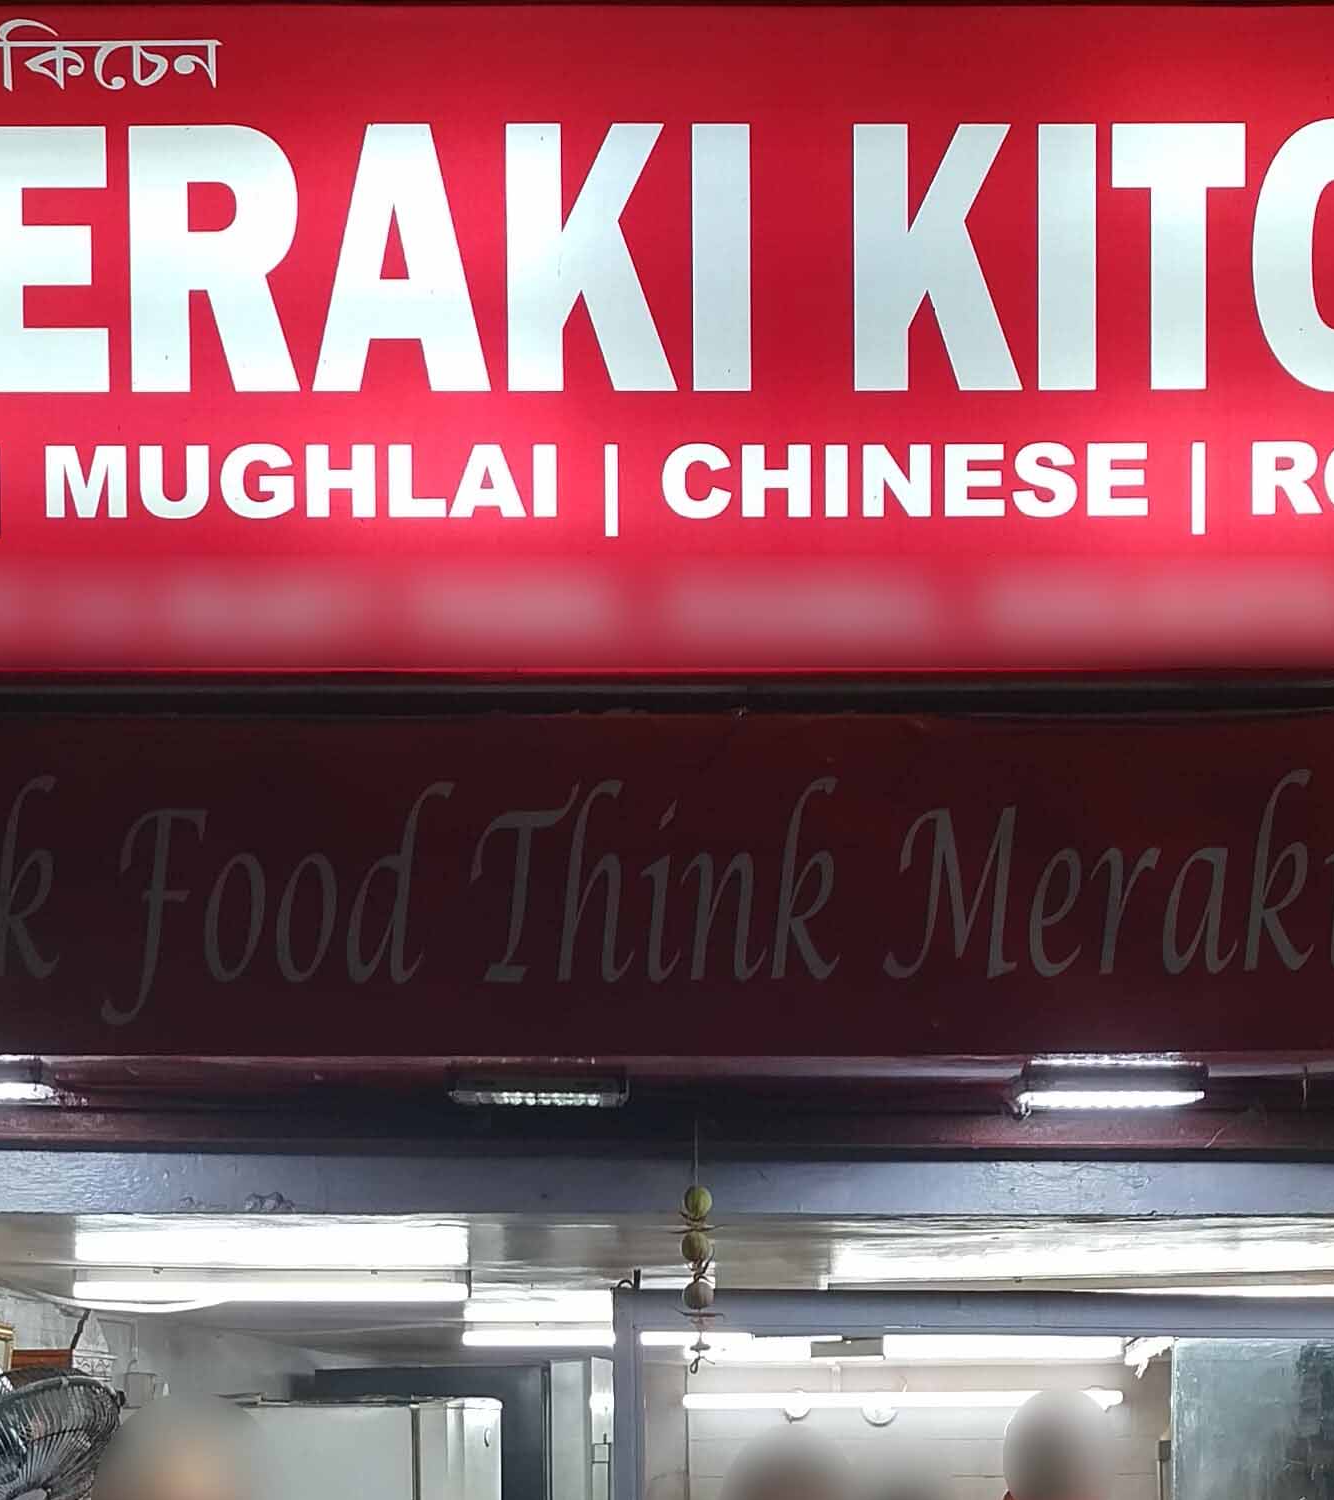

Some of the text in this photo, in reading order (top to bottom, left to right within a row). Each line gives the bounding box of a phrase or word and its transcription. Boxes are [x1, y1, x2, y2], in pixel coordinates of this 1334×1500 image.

[44, 443, 558, 519] MUGHLAI
[661, 442, 1149, 519] CHINESE
[100, 780, 456, 1026] Food
[470, 778, 840, 984] Think
